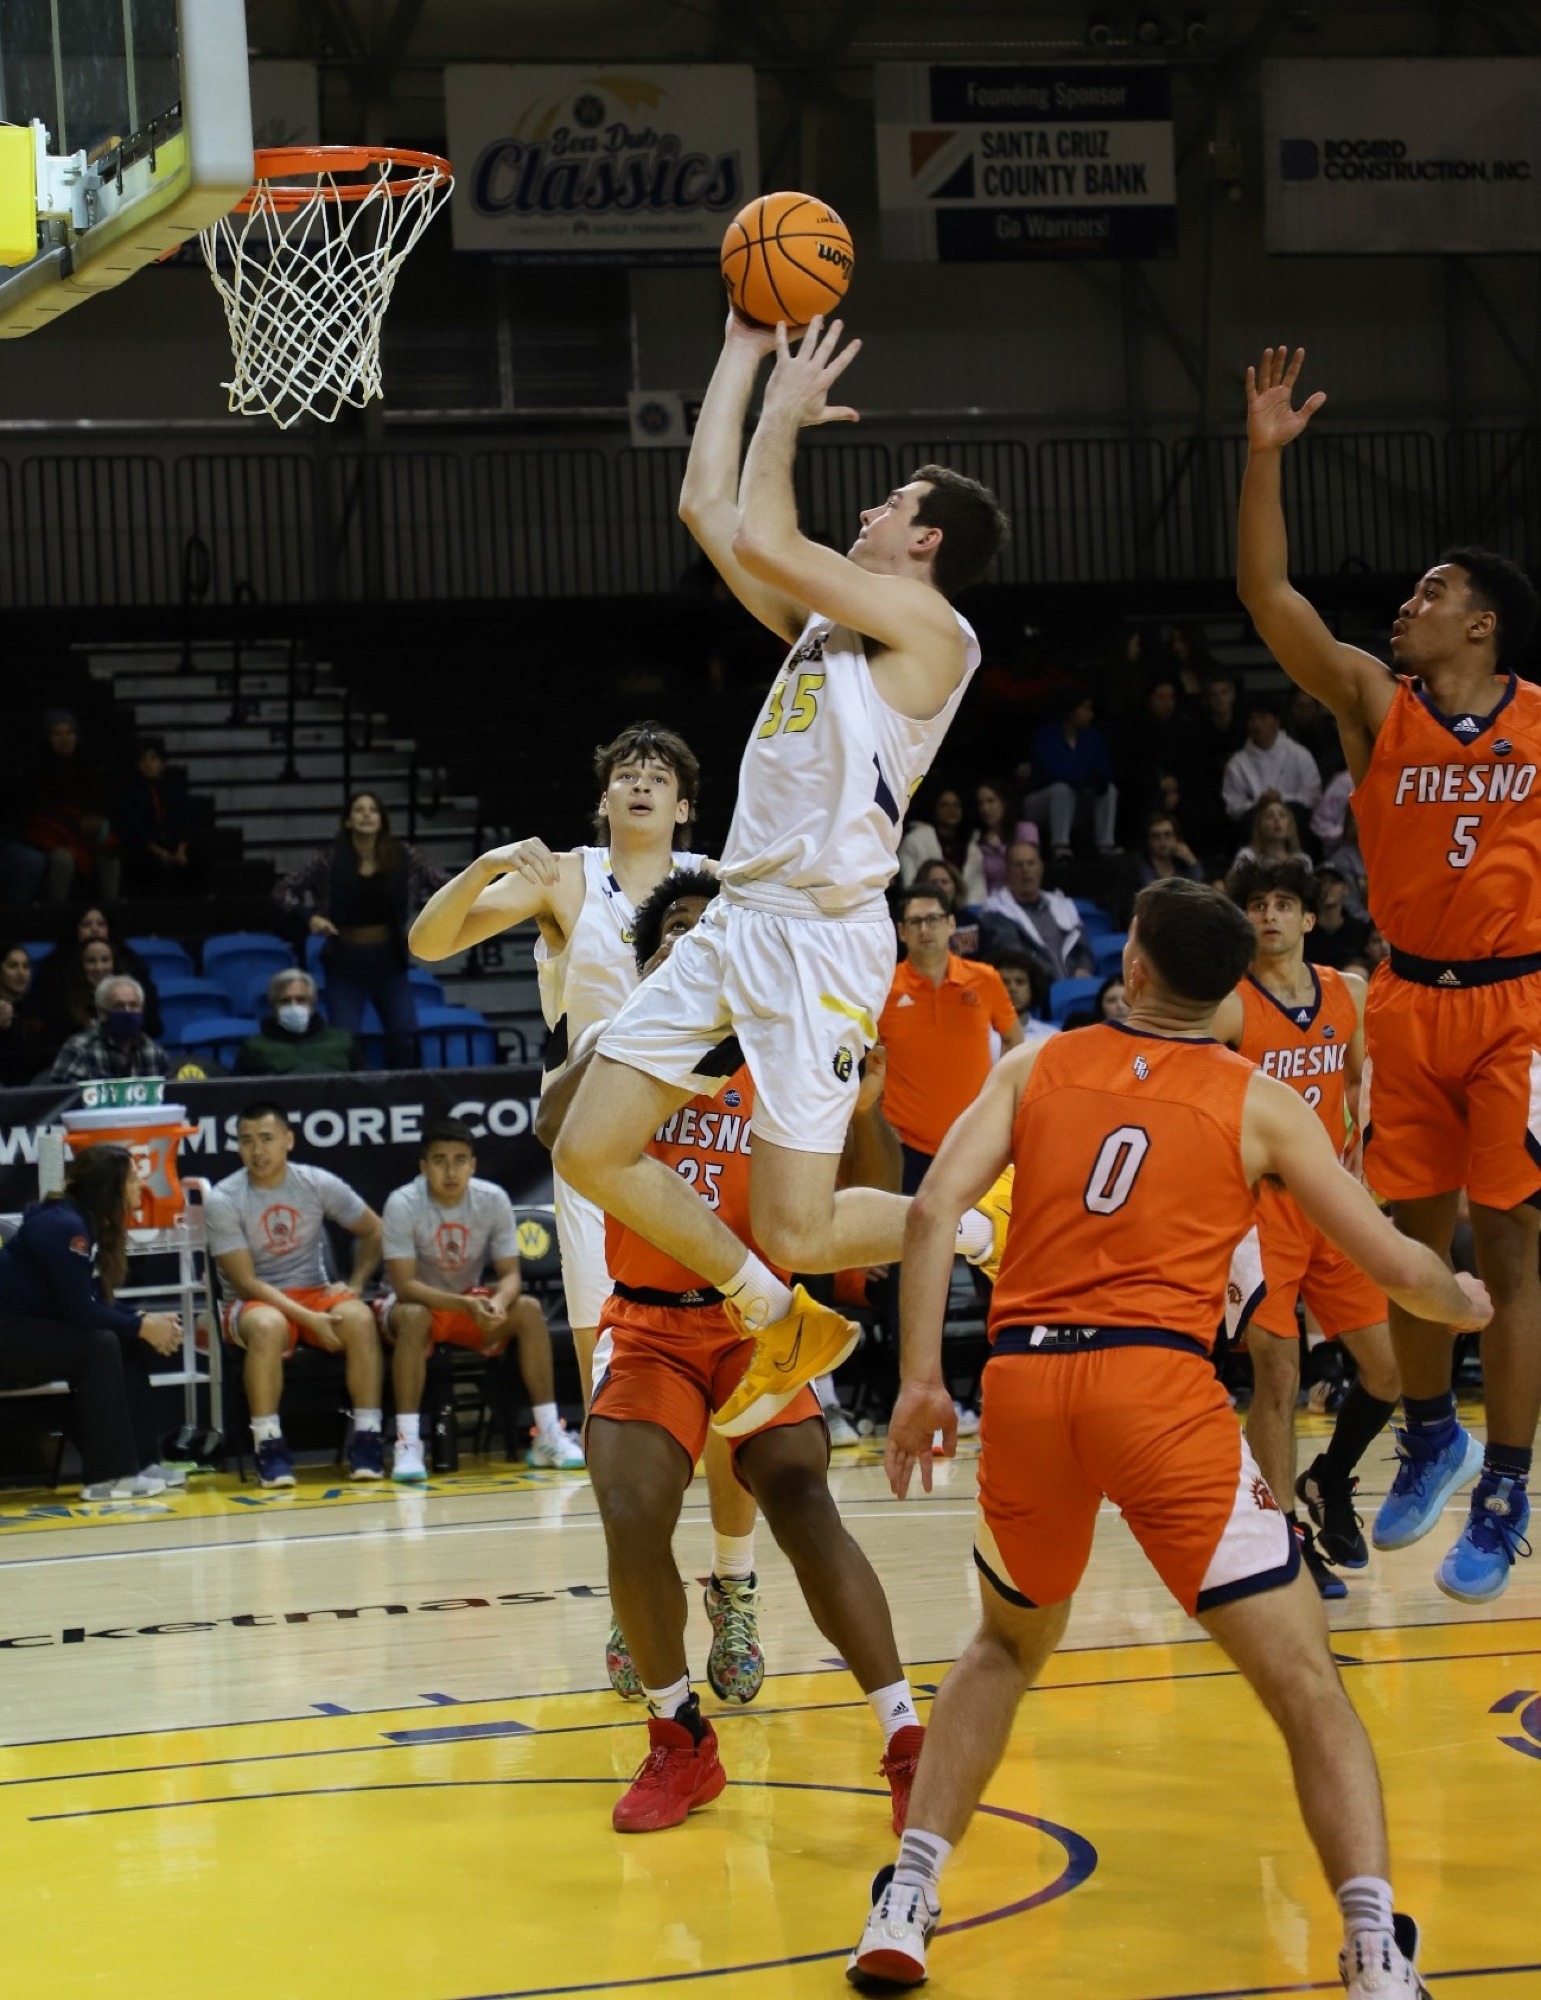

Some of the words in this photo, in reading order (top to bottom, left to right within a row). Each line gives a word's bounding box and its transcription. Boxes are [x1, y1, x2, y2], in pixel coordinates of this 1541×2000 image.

[967, 81, 1050, 110] Founding
[1054, 81, 1127, 108] Sponsor
[981, 131, 1050, 159] SANTA
[1056, 130, 1110, 158] CRUZ
[1324, 140, 1407, 159] BOGARD
[471, 139, 742, 216] Classics
[983, 164, 1077, 196] COUNTY
[1085, 163, 1148, 195] BANK
[997, 214, 1021, 238] Go
[1028, 213, 1110, 238] Warriors!
[1394, 763, 1537, 805] FRESNO
[1447, 815, 1482, 868] 5
[655, 1107, 752, 1156] RESNO
[1083, 1124, 1152, 1217] 0
[0, 1578, 702, 1650] cketmast
